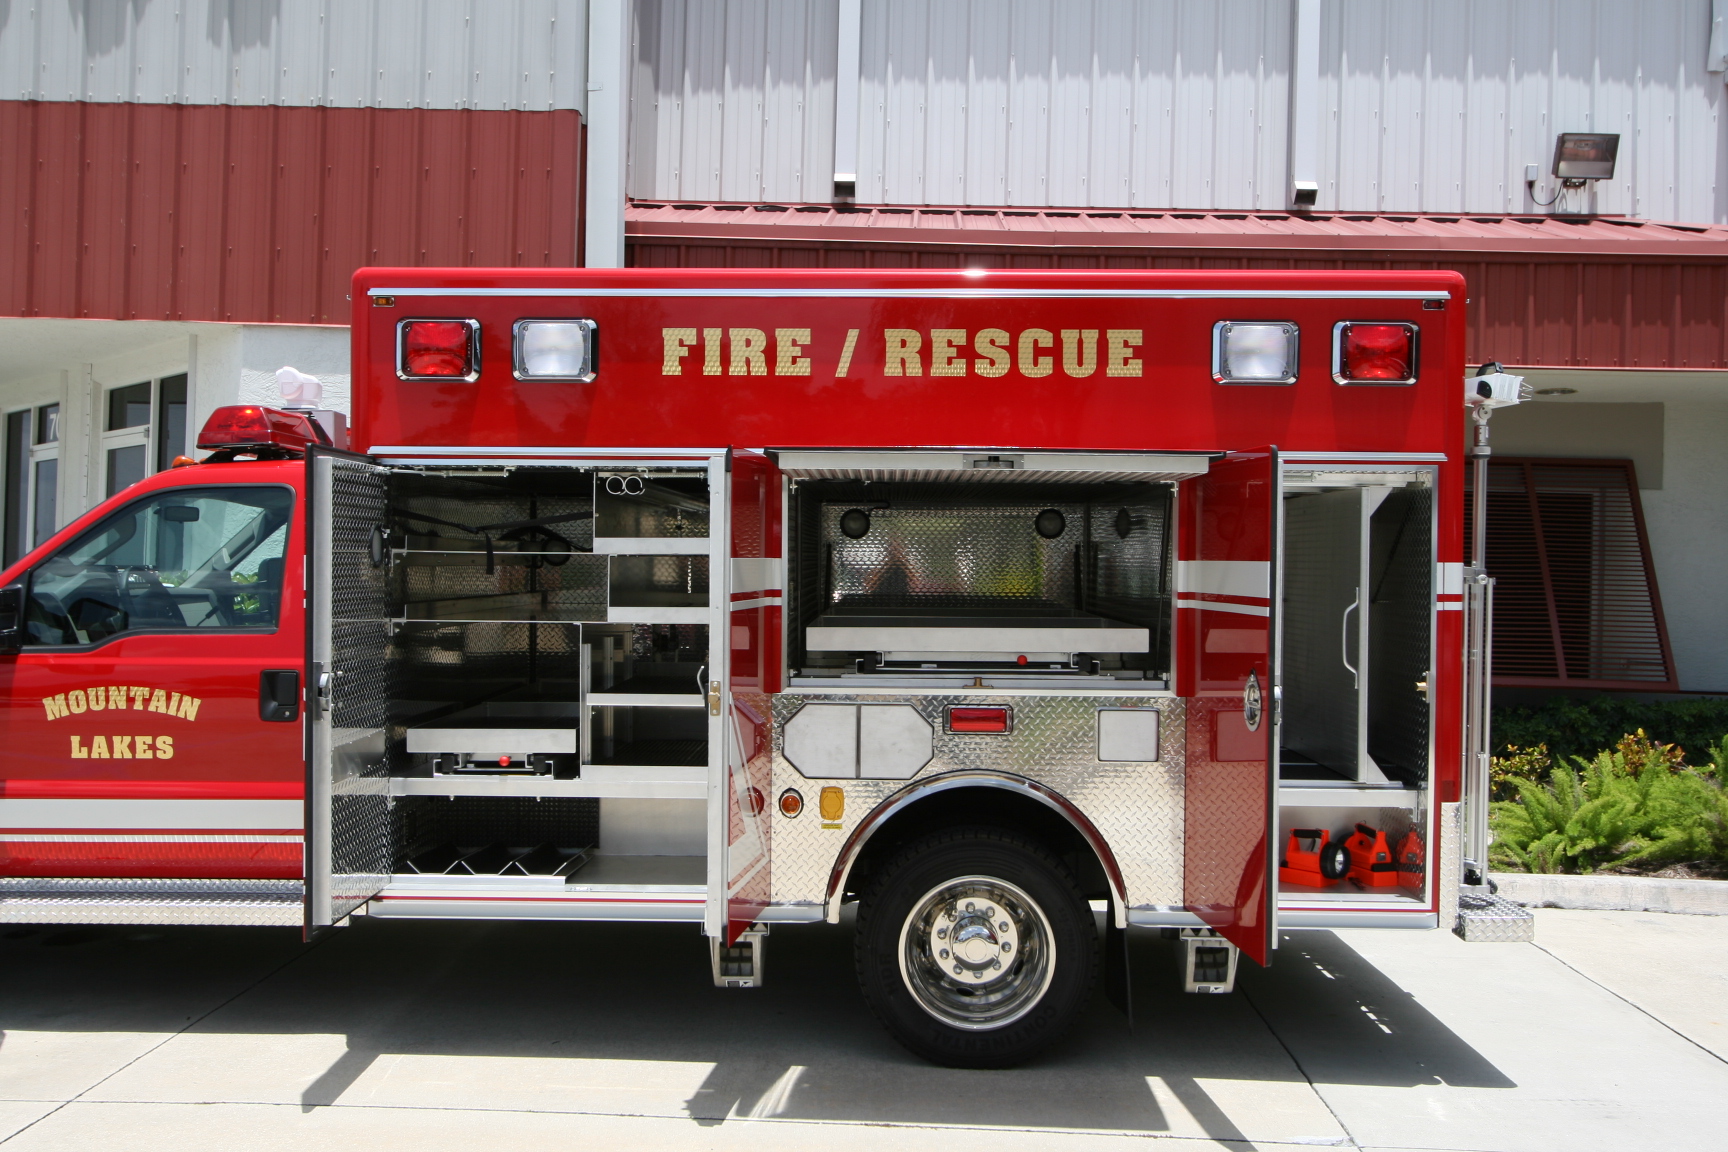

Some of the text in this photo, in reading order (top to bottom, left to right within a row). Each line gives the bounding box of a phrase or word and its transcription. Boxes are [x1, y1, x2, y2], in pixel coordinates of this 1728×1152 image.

[662, 328, 811, 376] FIRE
[884, 328, 1143, 378] RESCUE
[42, 686, 202, 722] MOUNTAIN
[70, 735, 175, 760] LAKES
[928, 1003, 1058, 1053] CONTINENTAL
